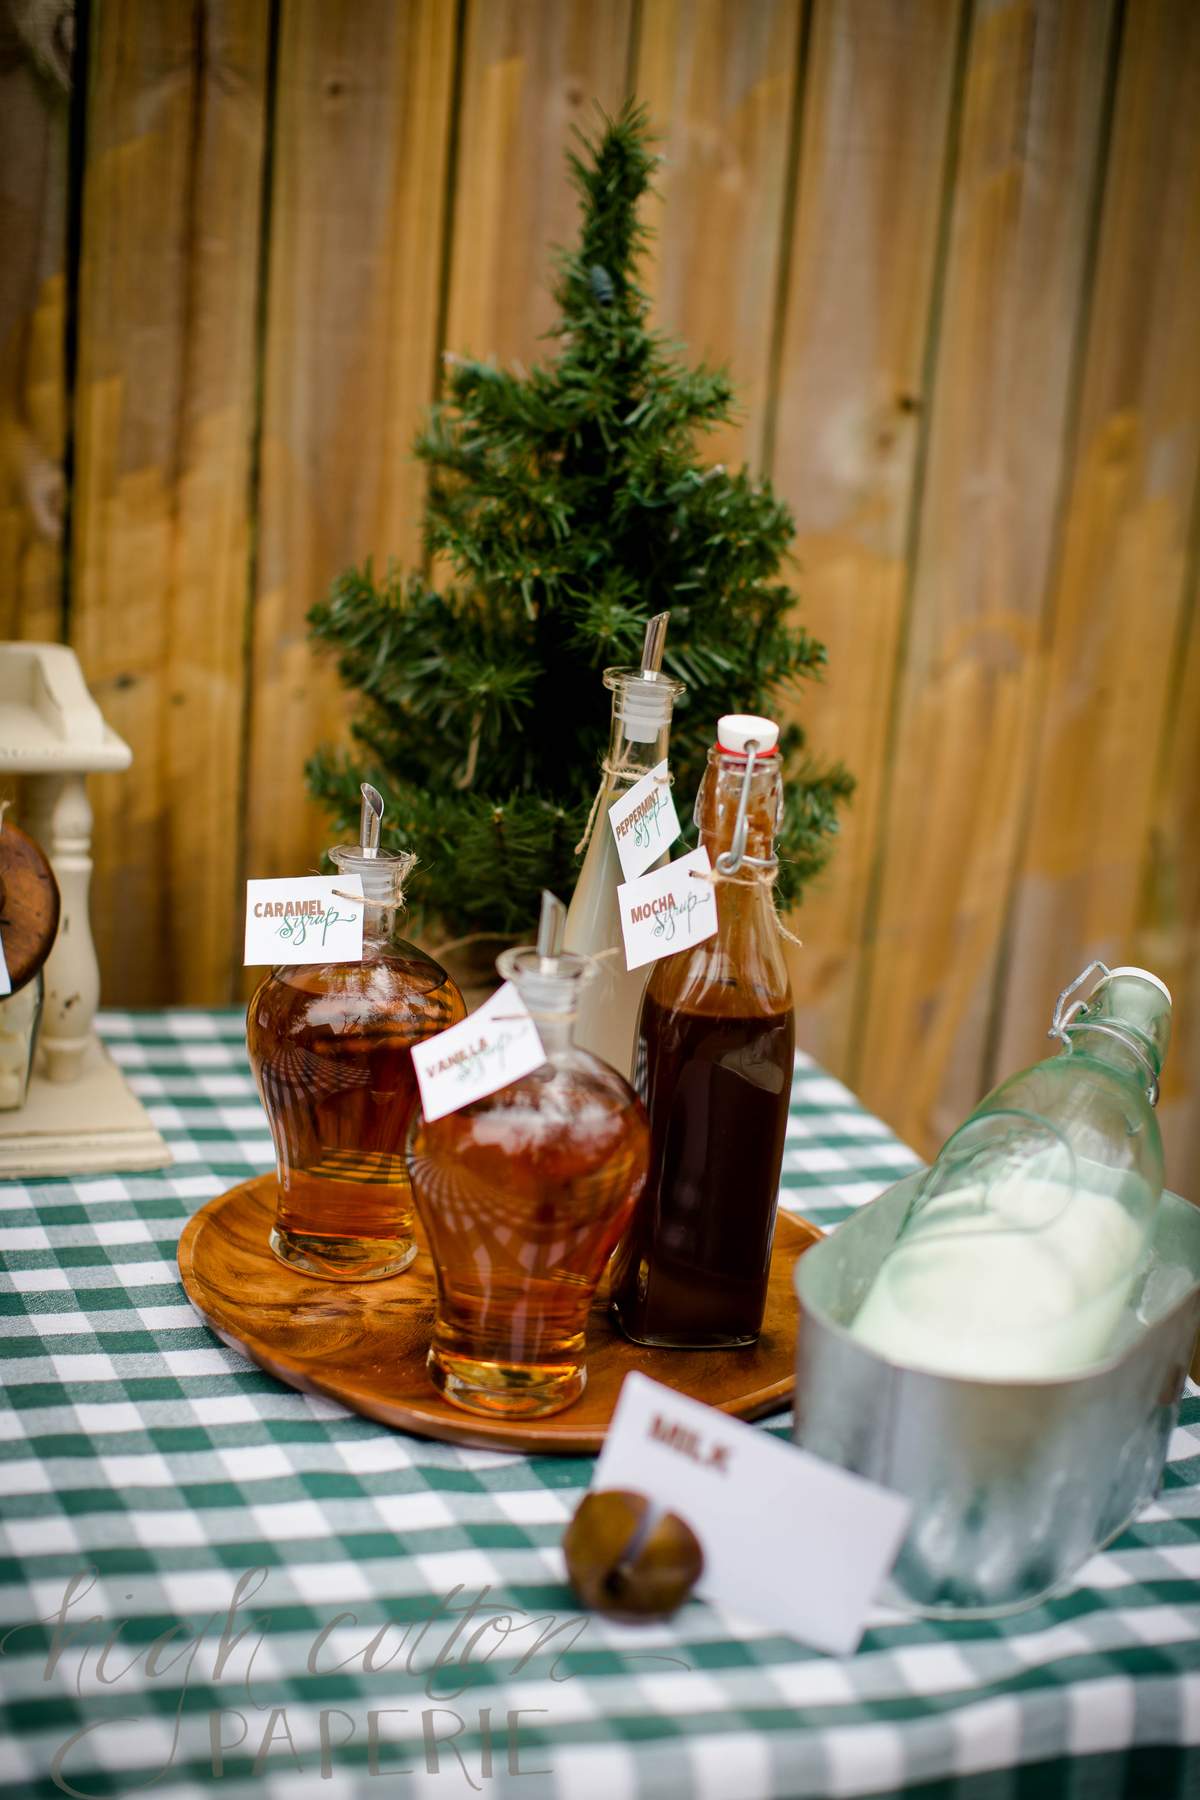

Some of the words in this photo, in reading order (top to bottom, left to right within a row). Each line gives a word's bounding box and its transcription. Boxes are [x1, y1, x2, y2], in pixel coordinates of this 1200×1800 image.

[615, 787, 660, 841] PEPPERMINT
[254, 900, 325, 918] CARAMEL
[630, 892, 676, 924] MOCHA
[649, 1413, 732, 1475] MILK
